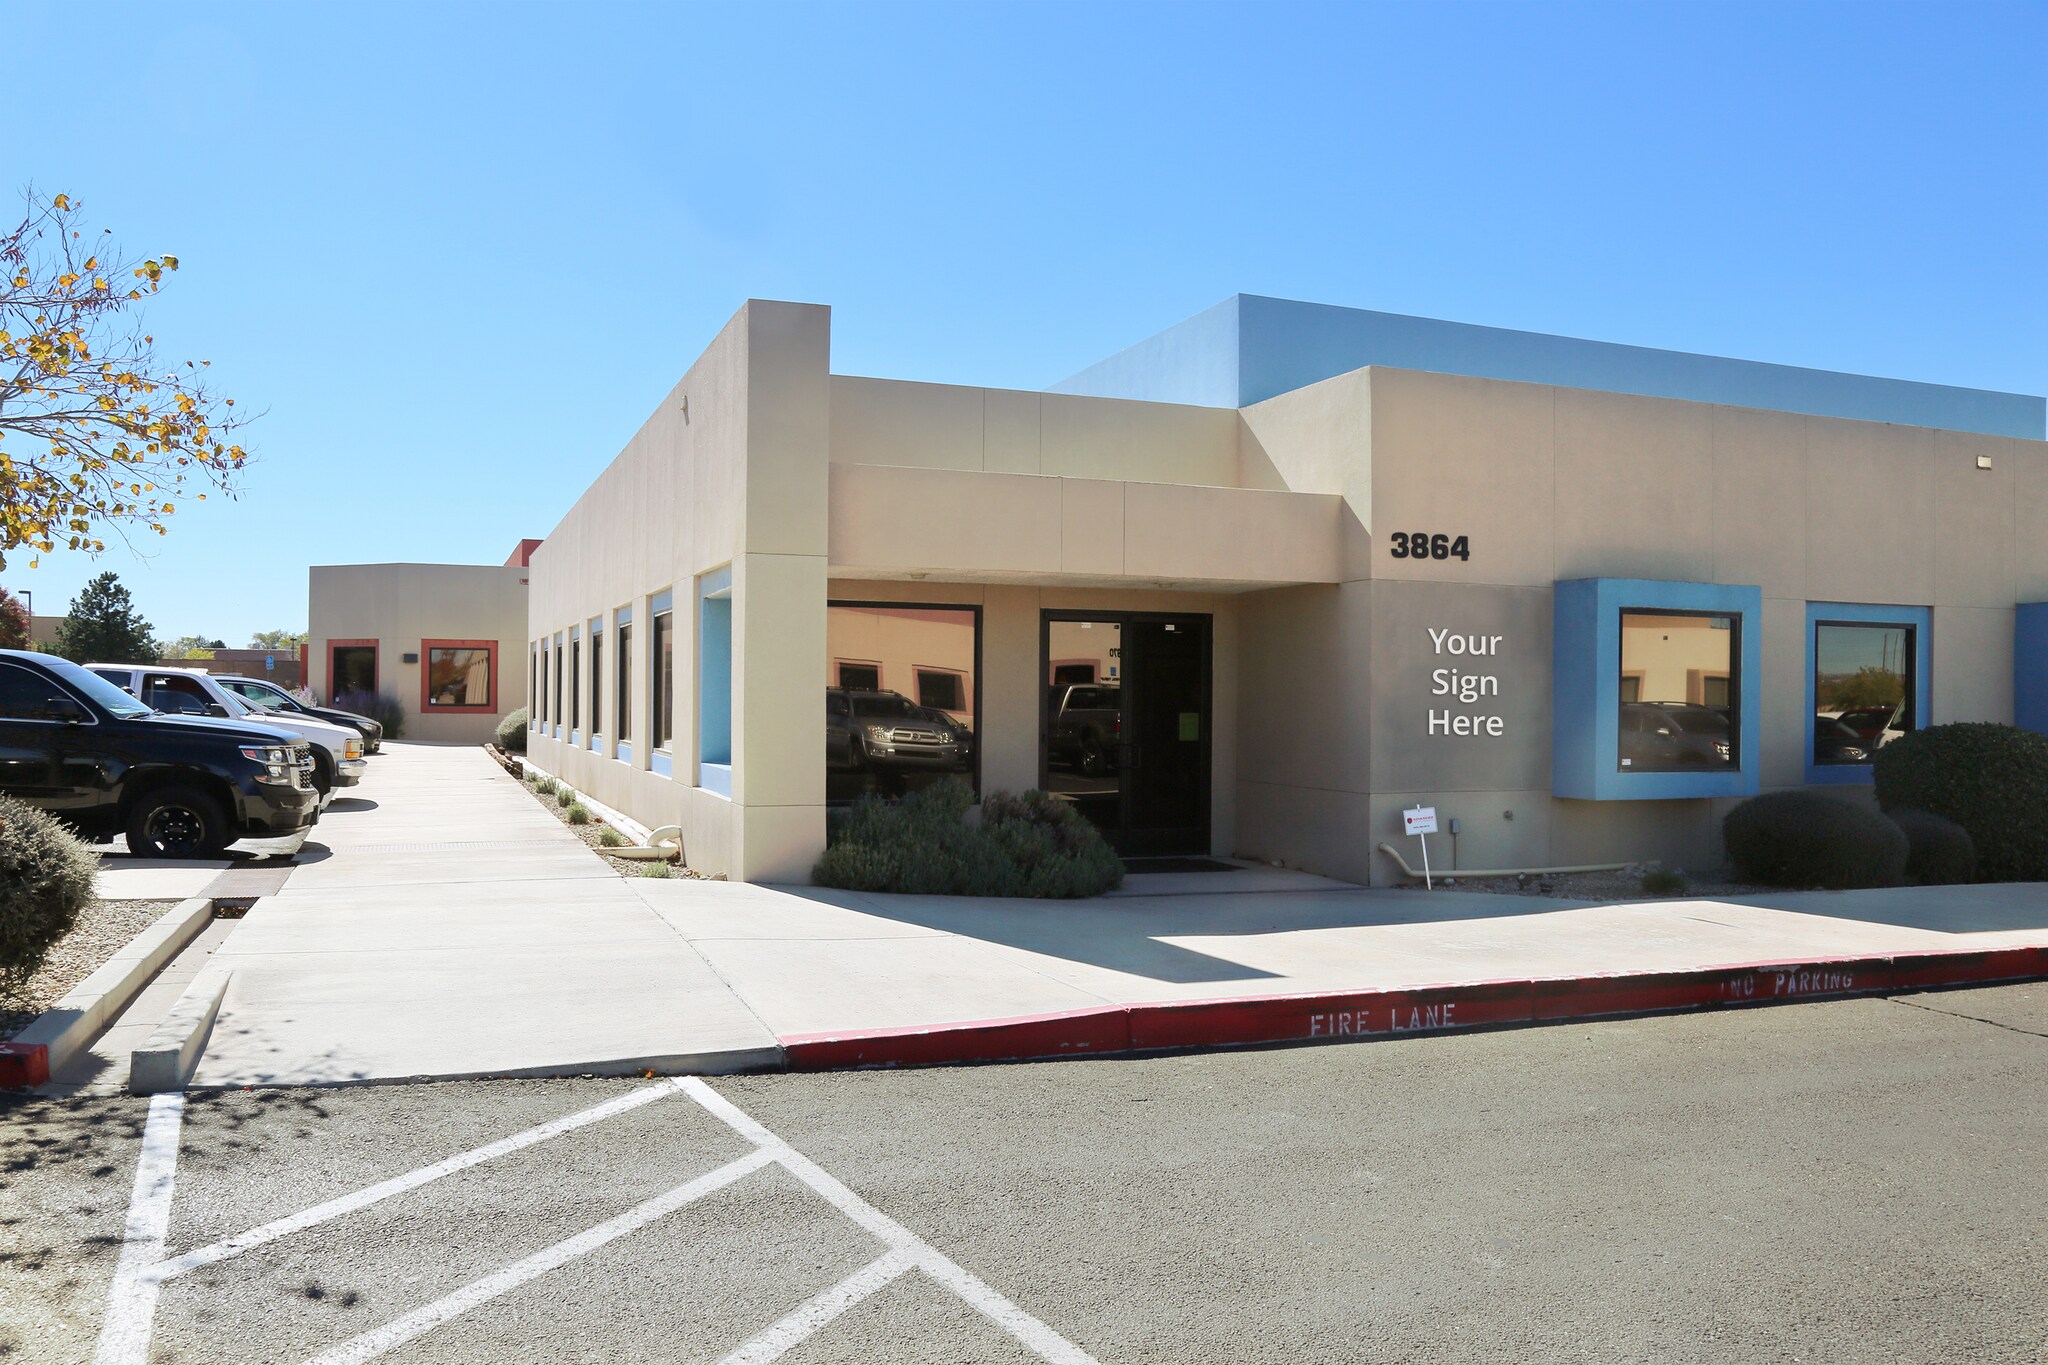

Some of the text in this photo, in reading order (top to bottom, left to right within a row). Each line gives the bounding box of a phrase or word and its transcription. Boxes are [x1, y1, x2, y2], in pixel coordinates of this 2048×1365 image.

[1391, 532, 1470, 561] 3864
[1774, 971, 1853, 994] PARKING
[1311, 1003, 1456, 1037] FIRE LANE
